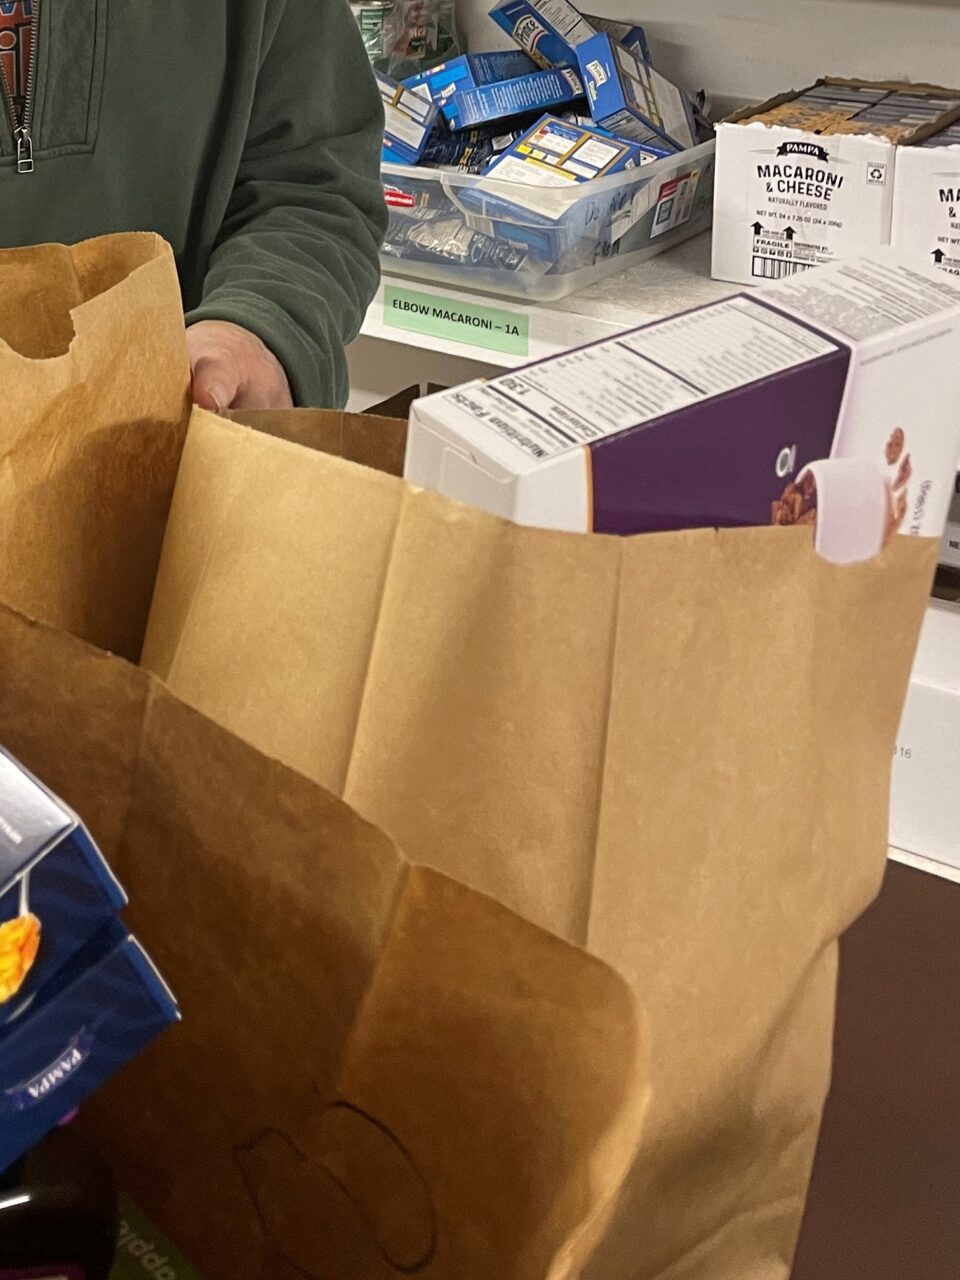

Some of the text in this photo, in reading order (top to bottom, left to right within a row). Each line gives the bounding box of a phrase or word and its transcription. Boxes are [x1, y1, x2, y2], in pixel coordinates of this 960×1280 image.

[516, 19, 540, 44] Prince
[786, 143, 819, 155] PAMPA
[757, 164, 844, 188] MACARONI
[766, 179, 833, 201] & CHEESE
[768, 196, 827, 211] NATURALLY FLAVORED
[949, 206, 957, 218] &
[756, 239, 790, 249] FRAGILE
[392, 299, 430, 316] ELBOW
[432, 308, 493, 331] MACARONI
[505, 323, 520, 337] 1A
[451, 392, 550, 458] Nutrition Facts
[549, 405, 599, 439] Calories
[28, 1047, 83, 1099] PAMPA
